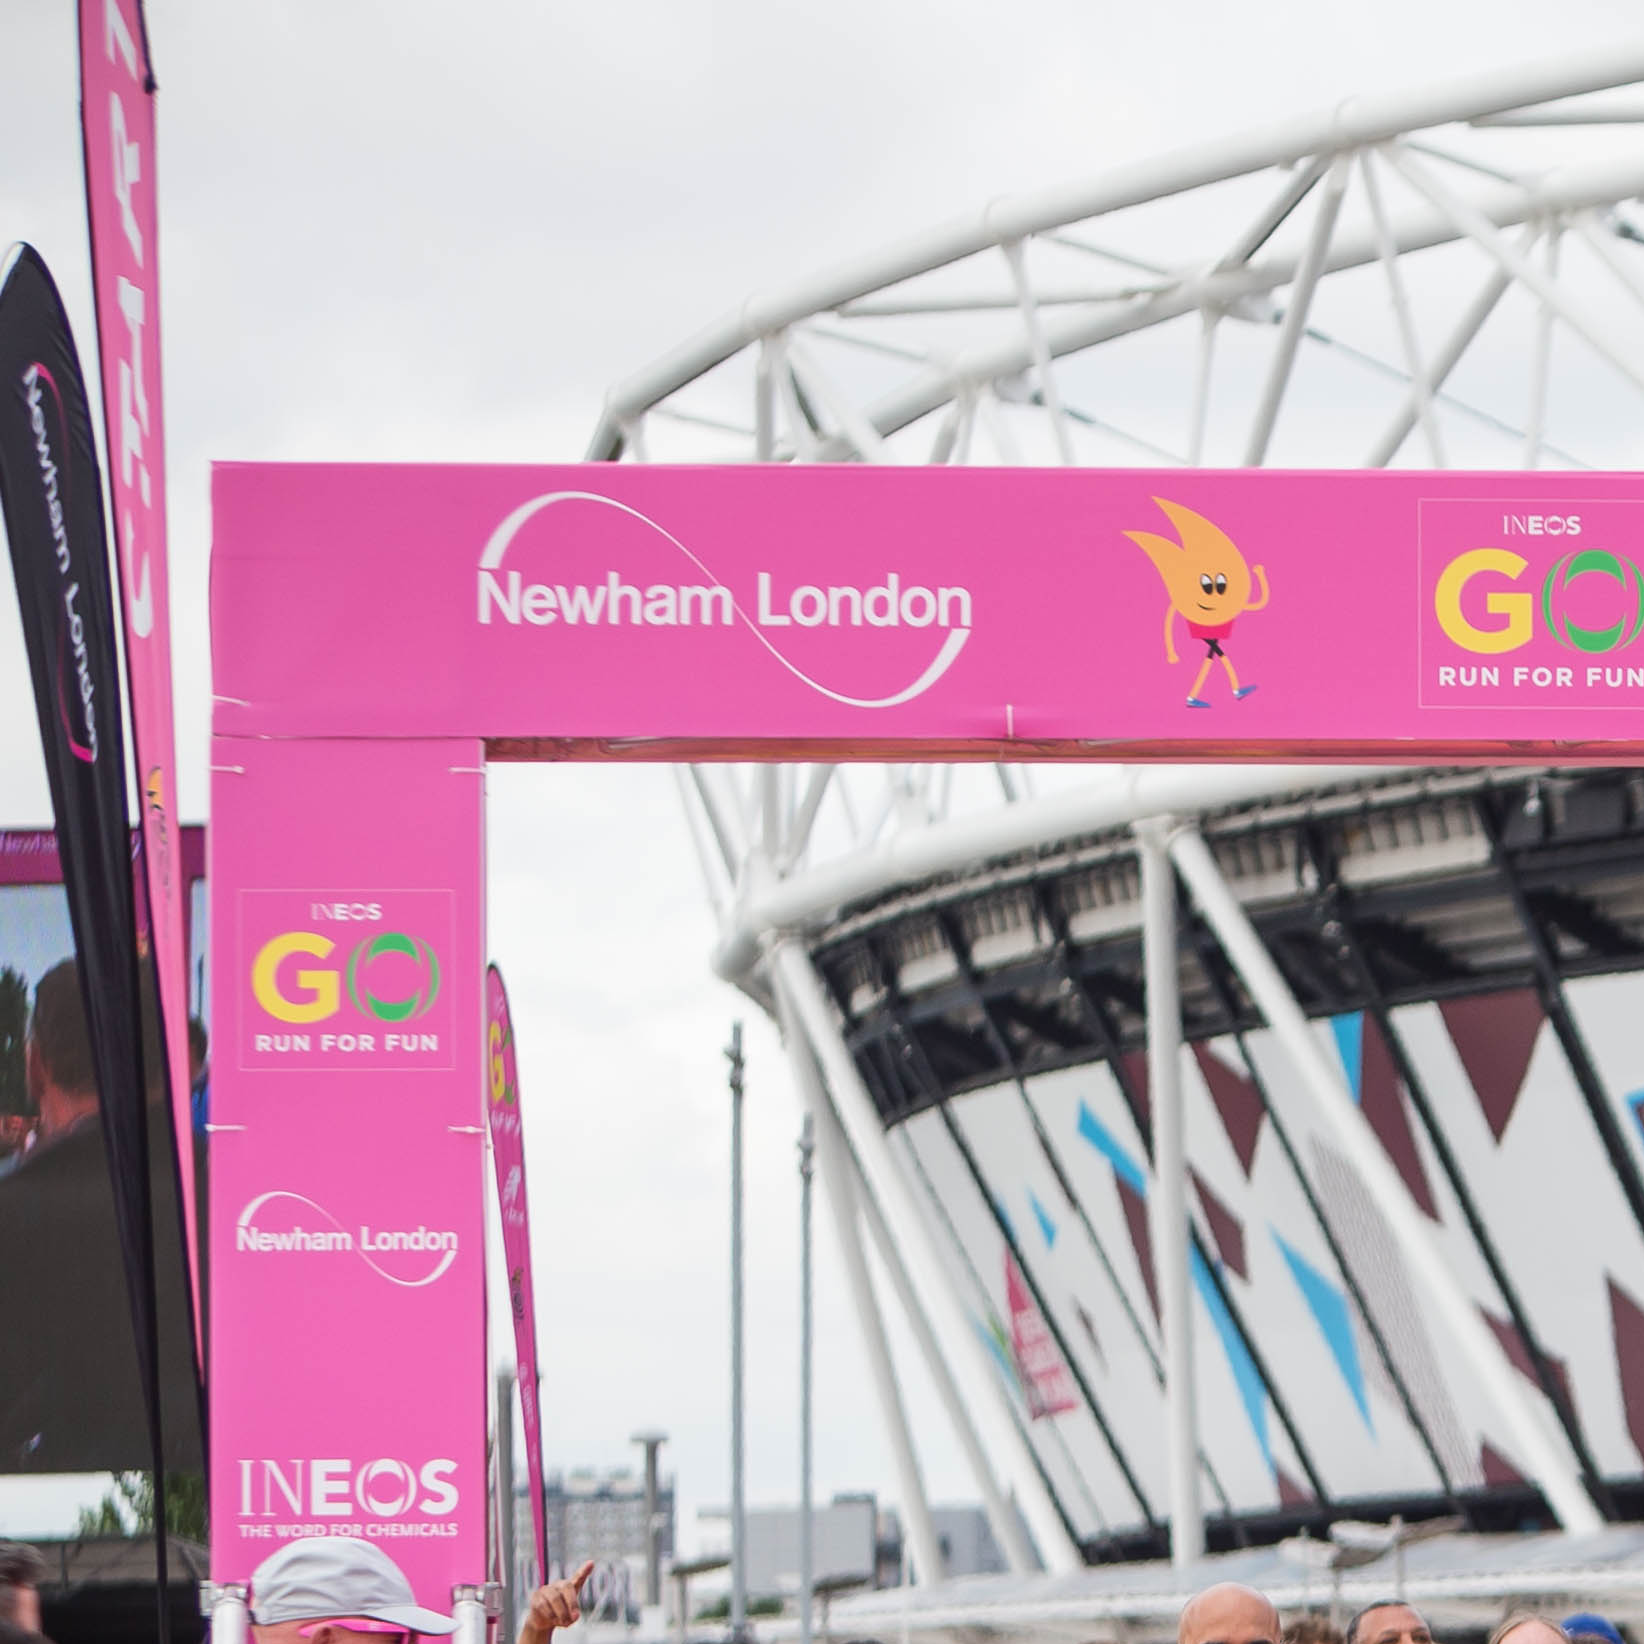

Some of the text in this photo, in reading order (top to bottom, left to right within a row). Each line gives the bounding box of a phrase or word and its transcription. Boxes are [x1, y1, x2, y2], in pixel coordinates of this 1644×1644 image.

[1503, 516, 1580, 535] INEOS
[22, 364, 99, 748] Newham London
[477, 571, 972, 628] Newham London
[1438, 665, 1500, 688] RUN
[1513, 665, 1577, 688] FOR
[312, 903, 383, 921] INEOS
[252, 931, 441, 1024] GO
[255, 1033, 439, 1053] RUN FOR FUN
[235, 1224, 459, 1252] Newham London
[238, 1458, 460, 1519] INEOS
[239, 1523, 459, 1538] THE WORD FOR CHEMICALS
